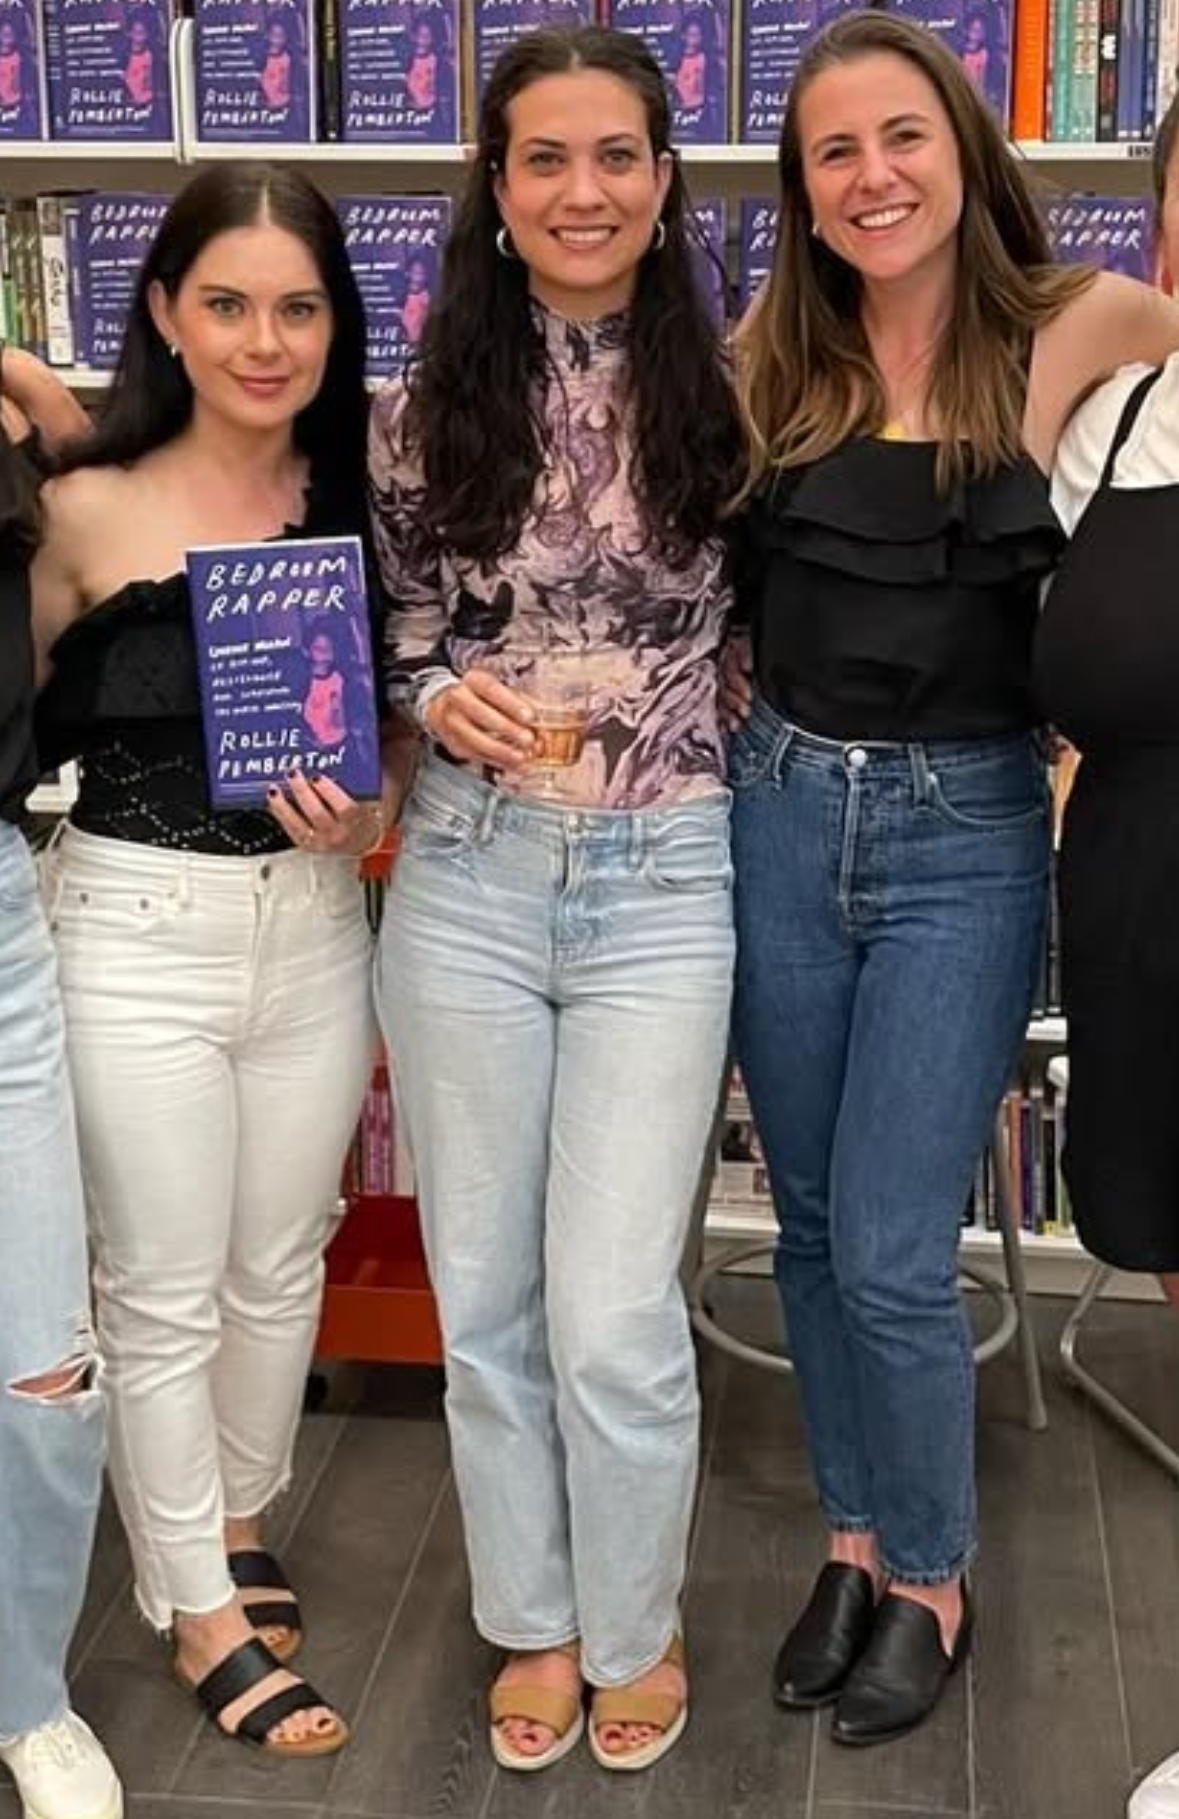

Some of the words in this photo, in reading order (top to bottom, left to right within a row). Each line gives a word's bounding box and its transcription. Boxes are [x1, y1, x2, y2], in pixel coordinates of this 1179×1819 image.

[89, 225, 159, 246] RAPPE
[206, 556, 347, 591] BEDROOM
[206, 585, 346, 623] RAPPER
[220, 728, 300, 755] ROLLIE
[218, 745, 346, 779] PEMBERTON
